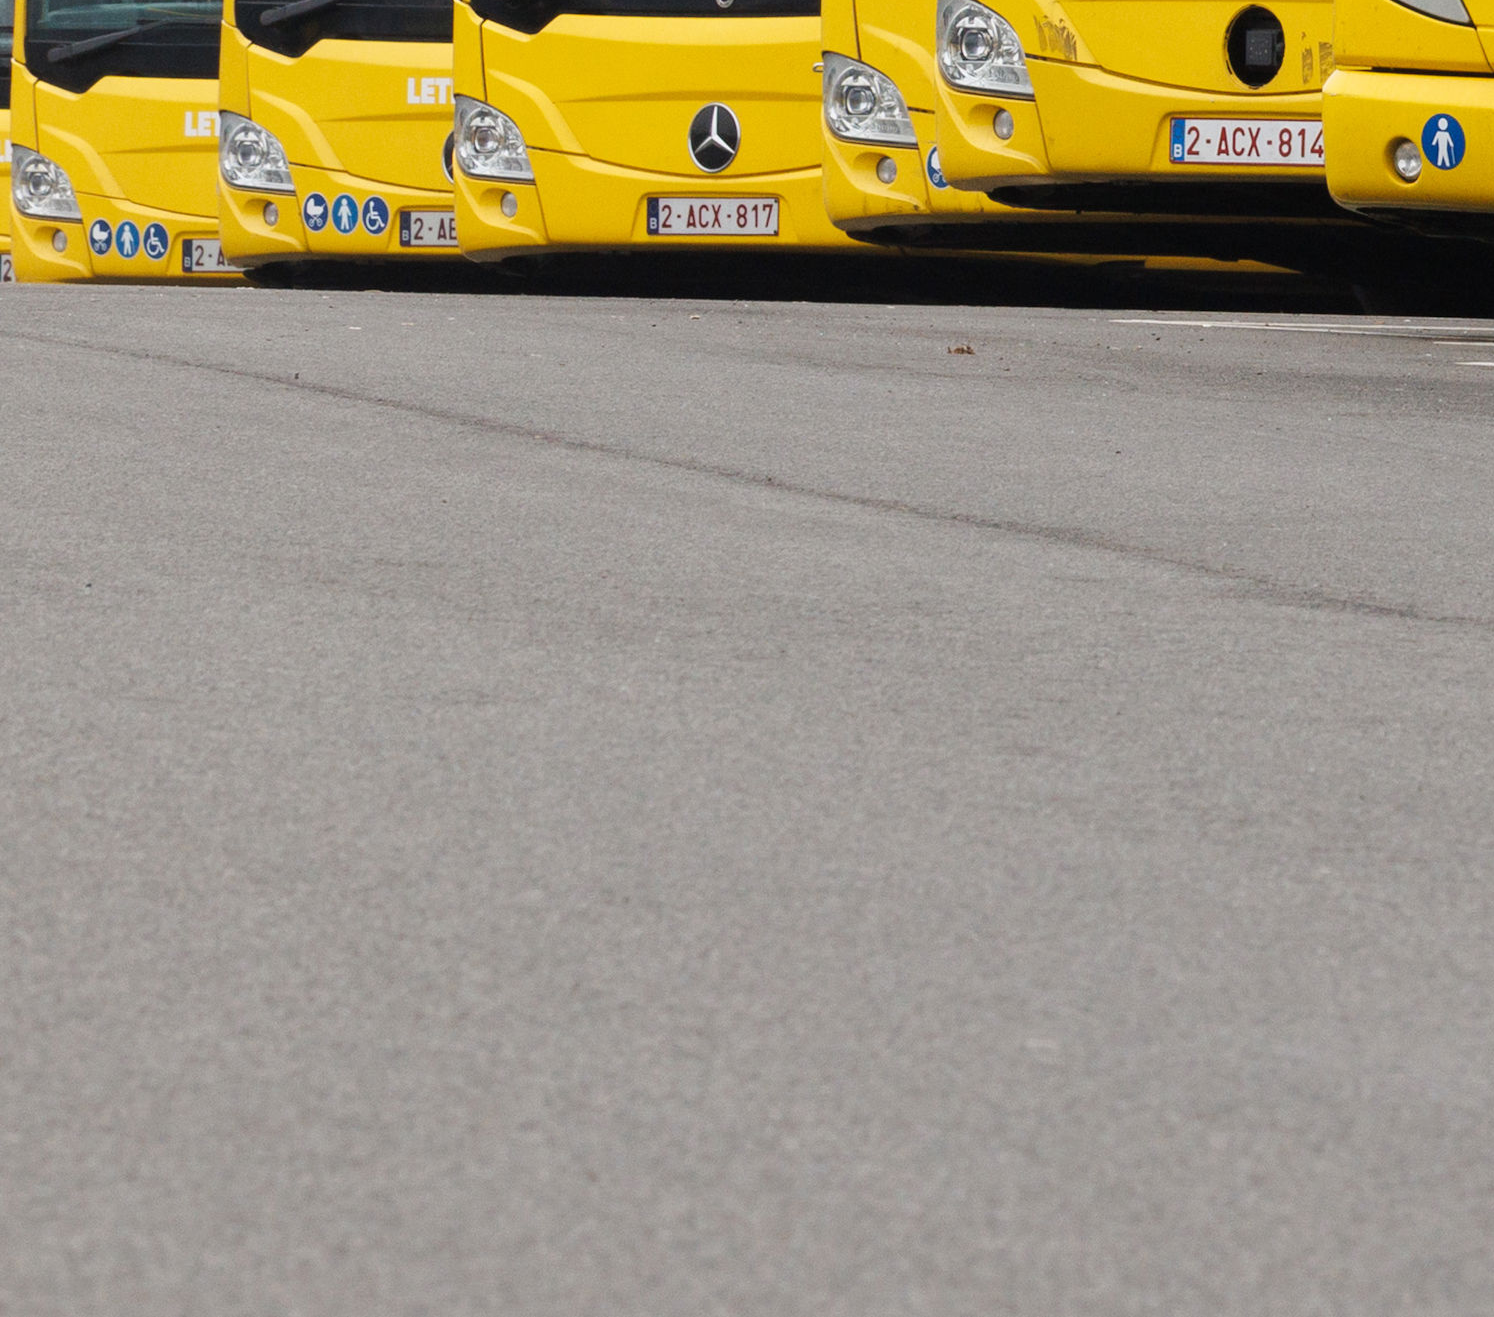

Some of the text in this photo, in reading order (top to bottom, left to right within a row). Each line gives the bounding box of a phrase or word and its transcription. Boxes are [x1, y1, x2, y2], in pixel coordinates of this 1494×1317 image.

[1173, 126, 1324, 158] B 2-ACX-814
[649, 204, 774, 229] B 2-ACX-817
[195, 245, 228, 266] 2-A
